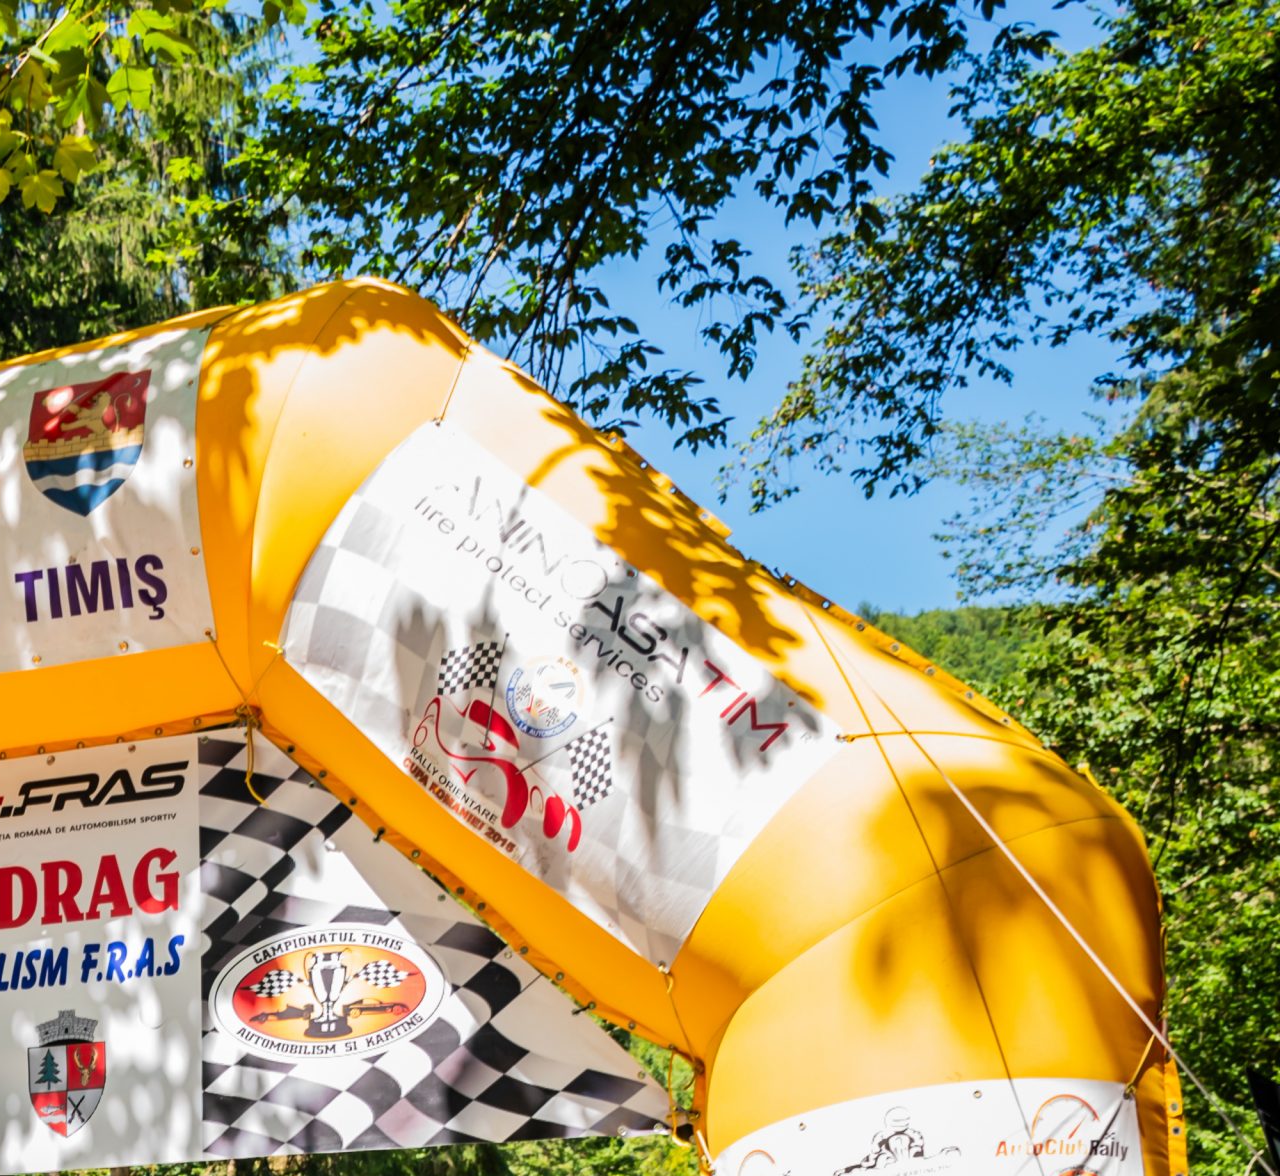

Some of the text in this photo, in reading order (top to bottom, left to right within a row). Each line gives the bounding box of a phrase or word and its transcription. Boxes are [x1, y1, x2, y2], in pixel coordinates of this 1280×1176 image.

[553, 610, 665, 704] services
[12, 760, 190, 817] FRAS
[403, 757, 429, 787] CUPA
[428, 781, 485, 831] ROMANIEI
[410, 746, 498, 825] RALLY ORIENTARE
[55, 825, 67, 834] DE
[69, 817, 137, 833] AUTOMOBILISM
[139, 812, 178, 824] SPORTIV
[81, 934, 185, 984] F.R.A.S
[252, 931, 404, 965] CAMPIONATUL TIMIS
[236, 1012, 424, 1056] AUTOMOBILISM SI KARTING
